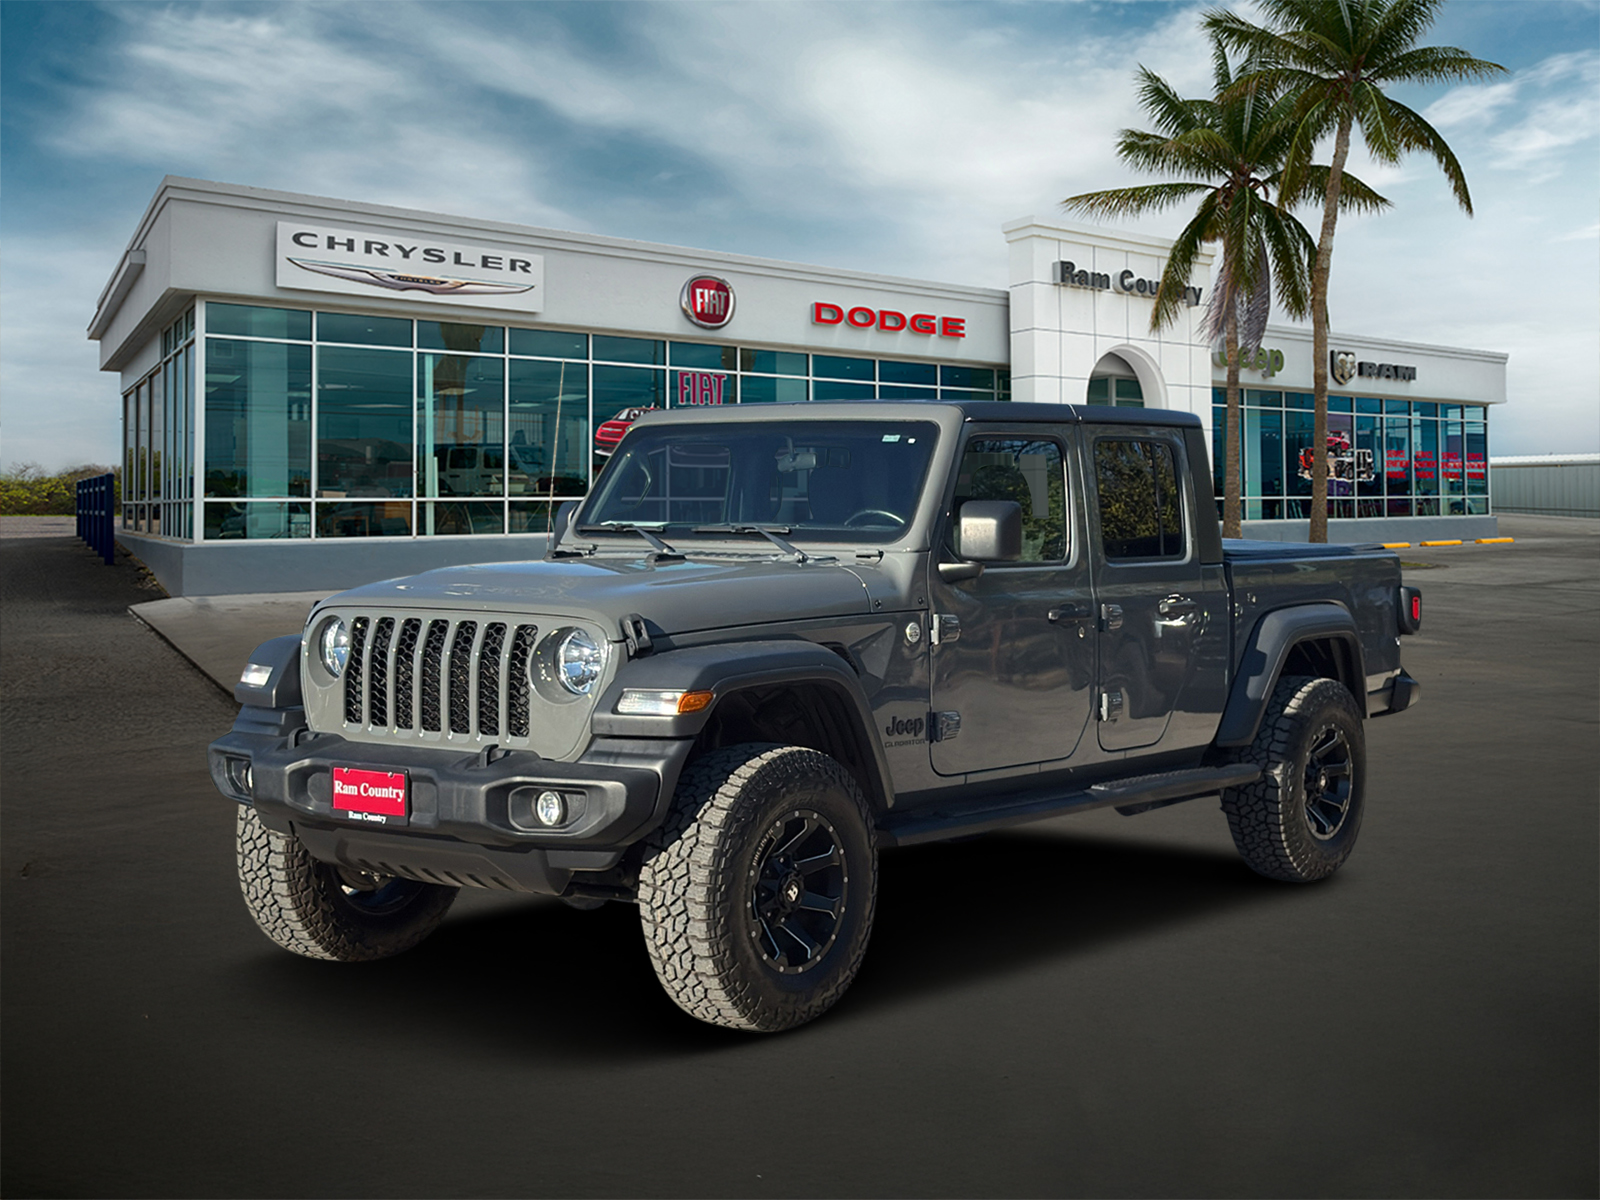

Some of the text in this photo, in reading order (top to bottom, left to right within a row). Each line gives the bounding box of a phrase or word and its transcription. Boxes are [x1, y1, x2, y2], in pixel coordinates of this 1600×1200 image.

[291, 231, 533, 274] CHRYSLER
[1052, 260, 1111, 291] Ram
[695, 288, 727, 316] FIAT
[812, 301, 967, 338] DODGE
[1358, 361, 1417, 381] RAM
[678, 370, 728, 405] FIAT
[886, 715, 924, 737] Jeep
[334, 780, 405, 802] Ram Country
[348, 810, 387, 824] Ram Country
